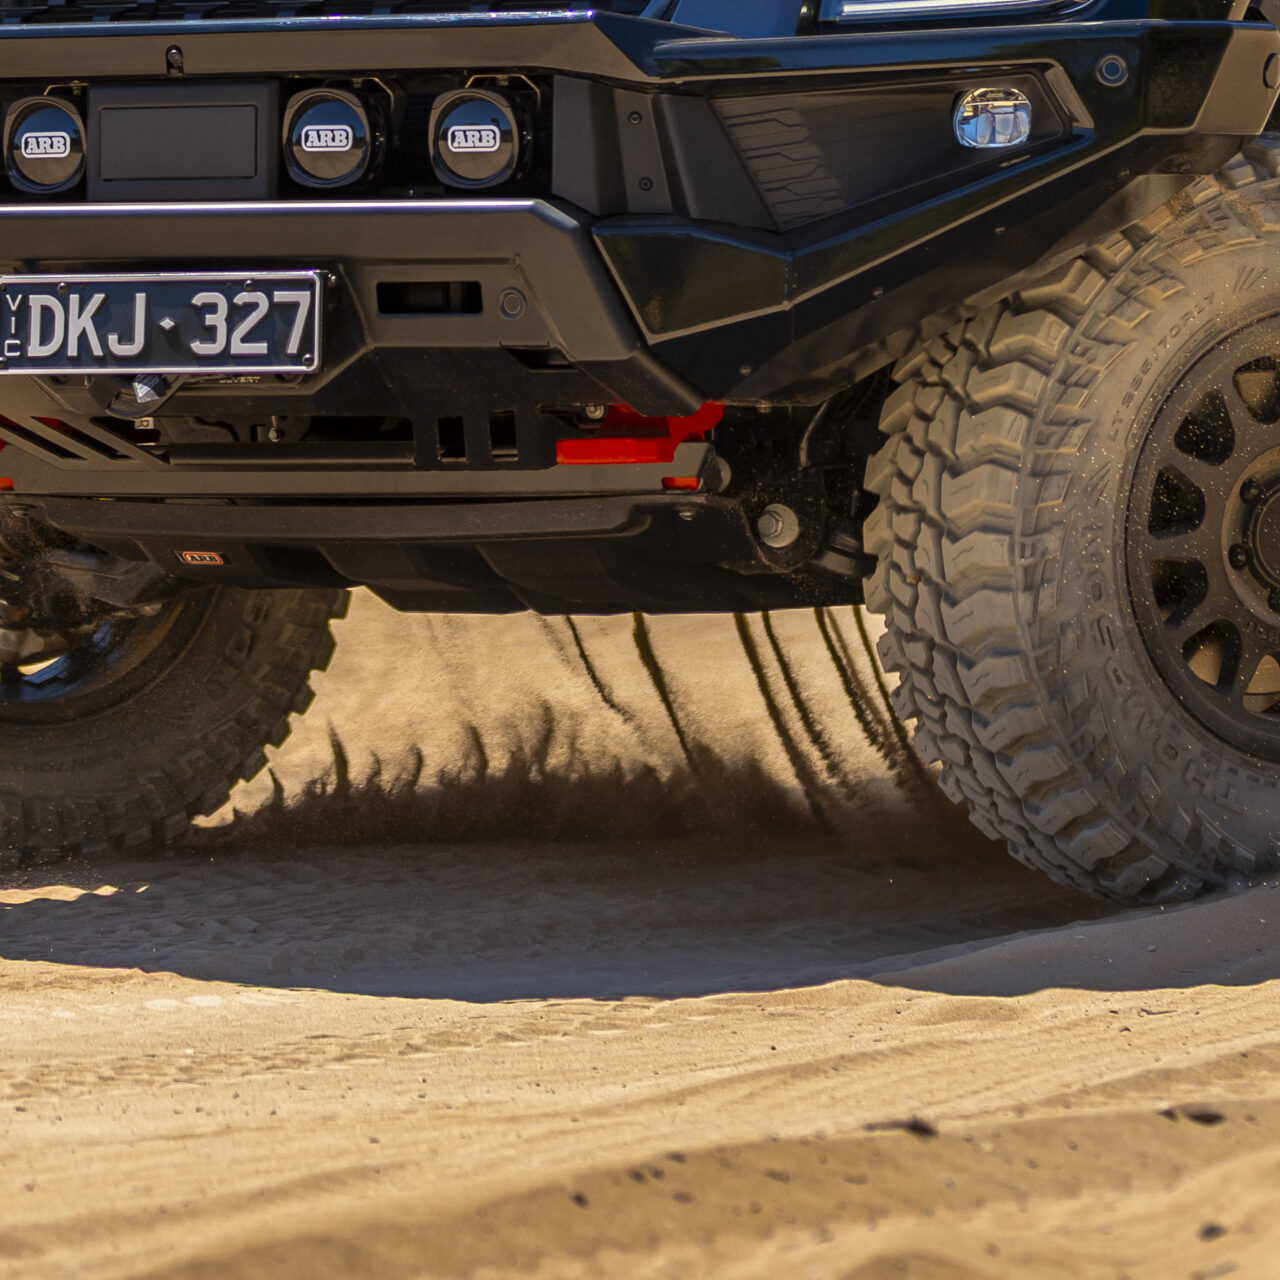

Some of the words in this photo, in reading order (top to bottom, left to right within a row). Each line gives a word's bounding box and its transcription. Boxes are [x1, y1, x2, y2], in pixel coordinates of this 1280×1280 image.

[24, 135, 67, 155] ARB
[305, 129, 349, 148] ARB
[451, 129, 496, 149] ARB
[3, 293, 23, 357] VIC
[26, 292, 147, 358] DKJ
[189, 290, 312, 357] 327
